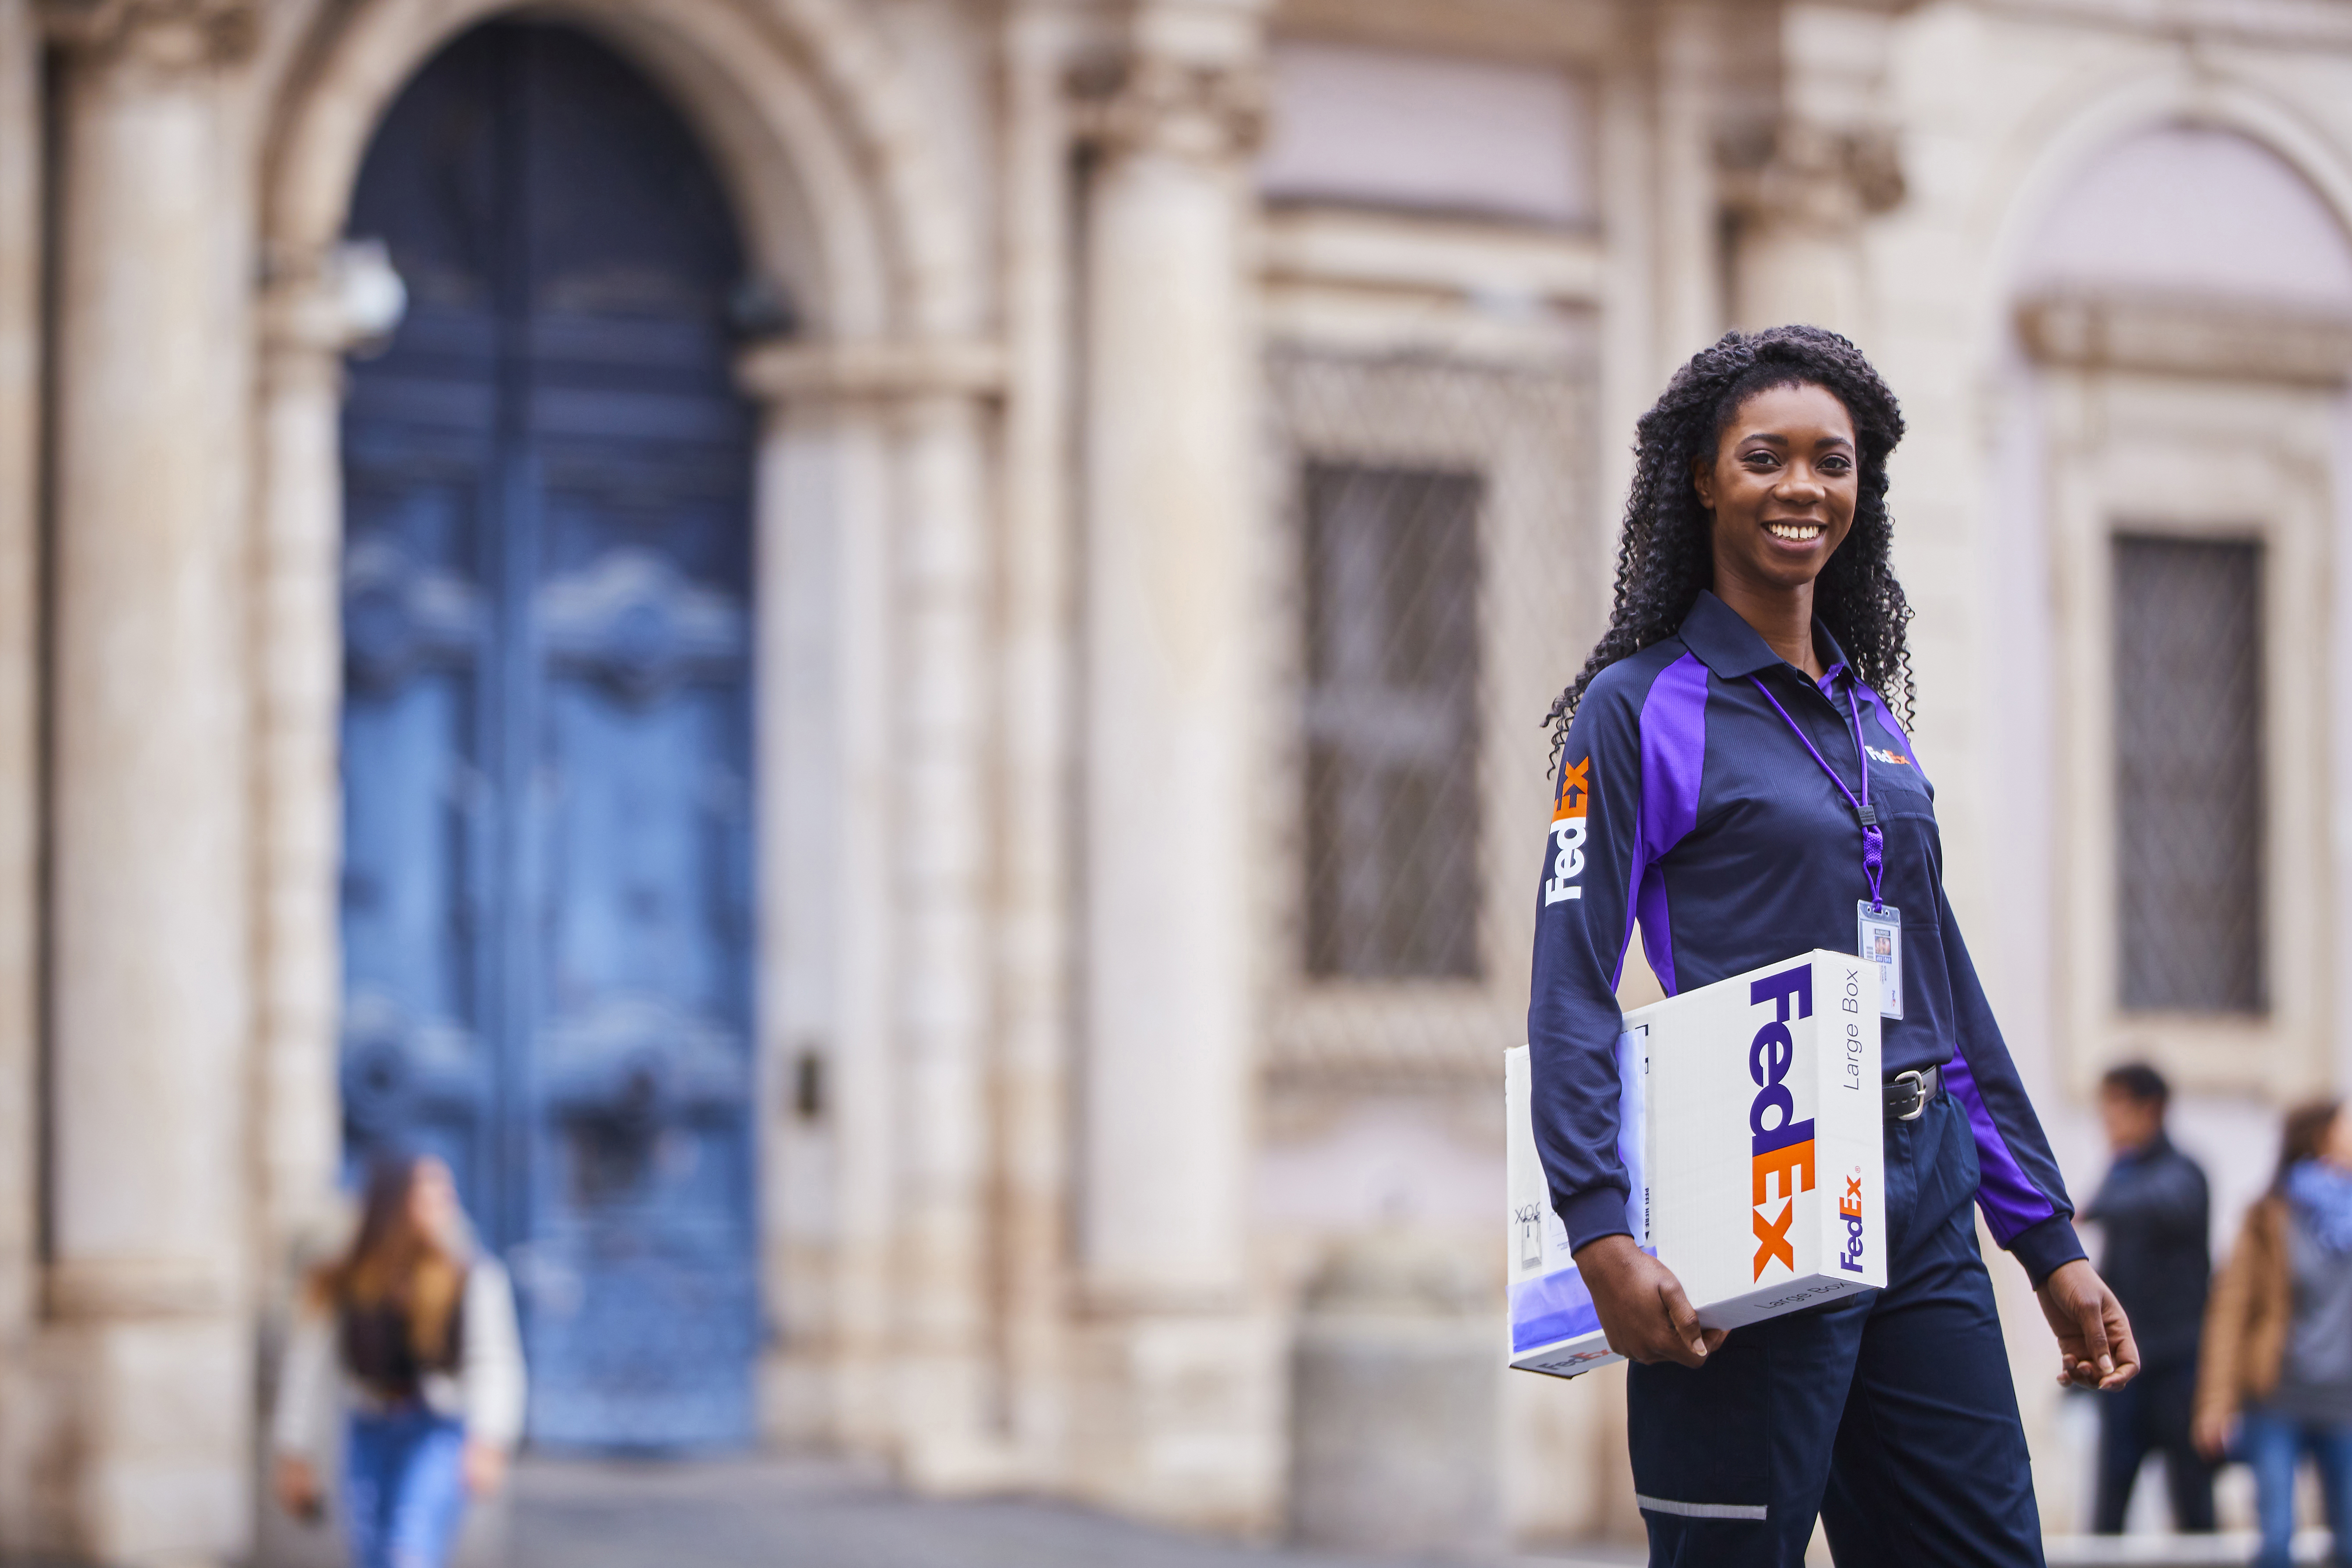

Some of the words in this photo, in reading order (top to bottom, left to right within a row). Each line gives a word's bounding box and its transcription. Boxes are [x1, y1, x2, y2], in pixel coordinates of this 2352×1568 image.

[1864, 745, 1910, 764] FedEx
[1545, 756, 1589, 907] FedEx
[1842, 968, 1858, 1014] Box
[1843, 1024, 1862, 1090] Large
[1749, 963, 1816, 1285] FedEx
[1754, 1293, 1812, 1309] Large
[1807, 1282, 1852, 1294] Box
[1536, 1349, 1614, 1370] FedEx
